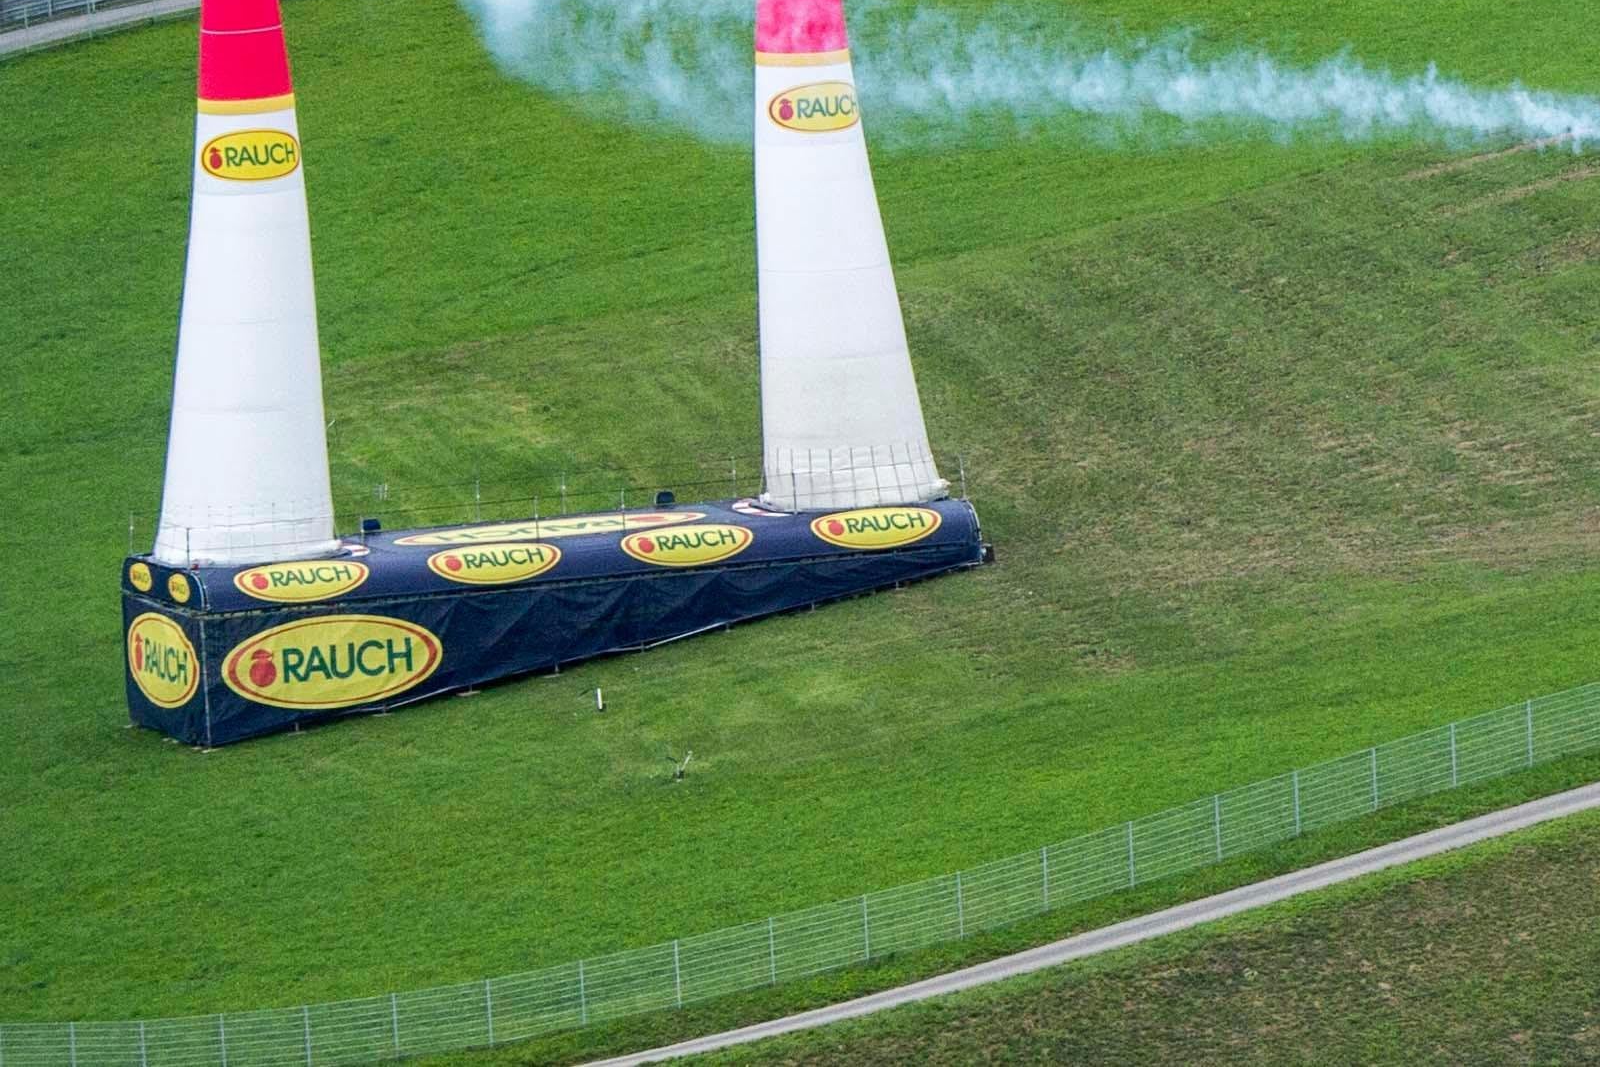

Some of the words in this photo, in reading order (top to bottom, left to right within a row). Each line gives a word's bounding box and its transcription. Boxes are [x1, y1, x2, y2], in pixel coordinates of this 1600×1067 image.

[224, 142, 296, 168] RAUCH
[845, 512, 926, 534] RAUCH
[656, 528, 738, 551] RAUCH
[464, 546, 545, 569] RAUCH
[269, 564, 352, 588] RAUCH
[143, 638, 188, 686] RAUCH
[282, 636, 414, 684] RAUCH
